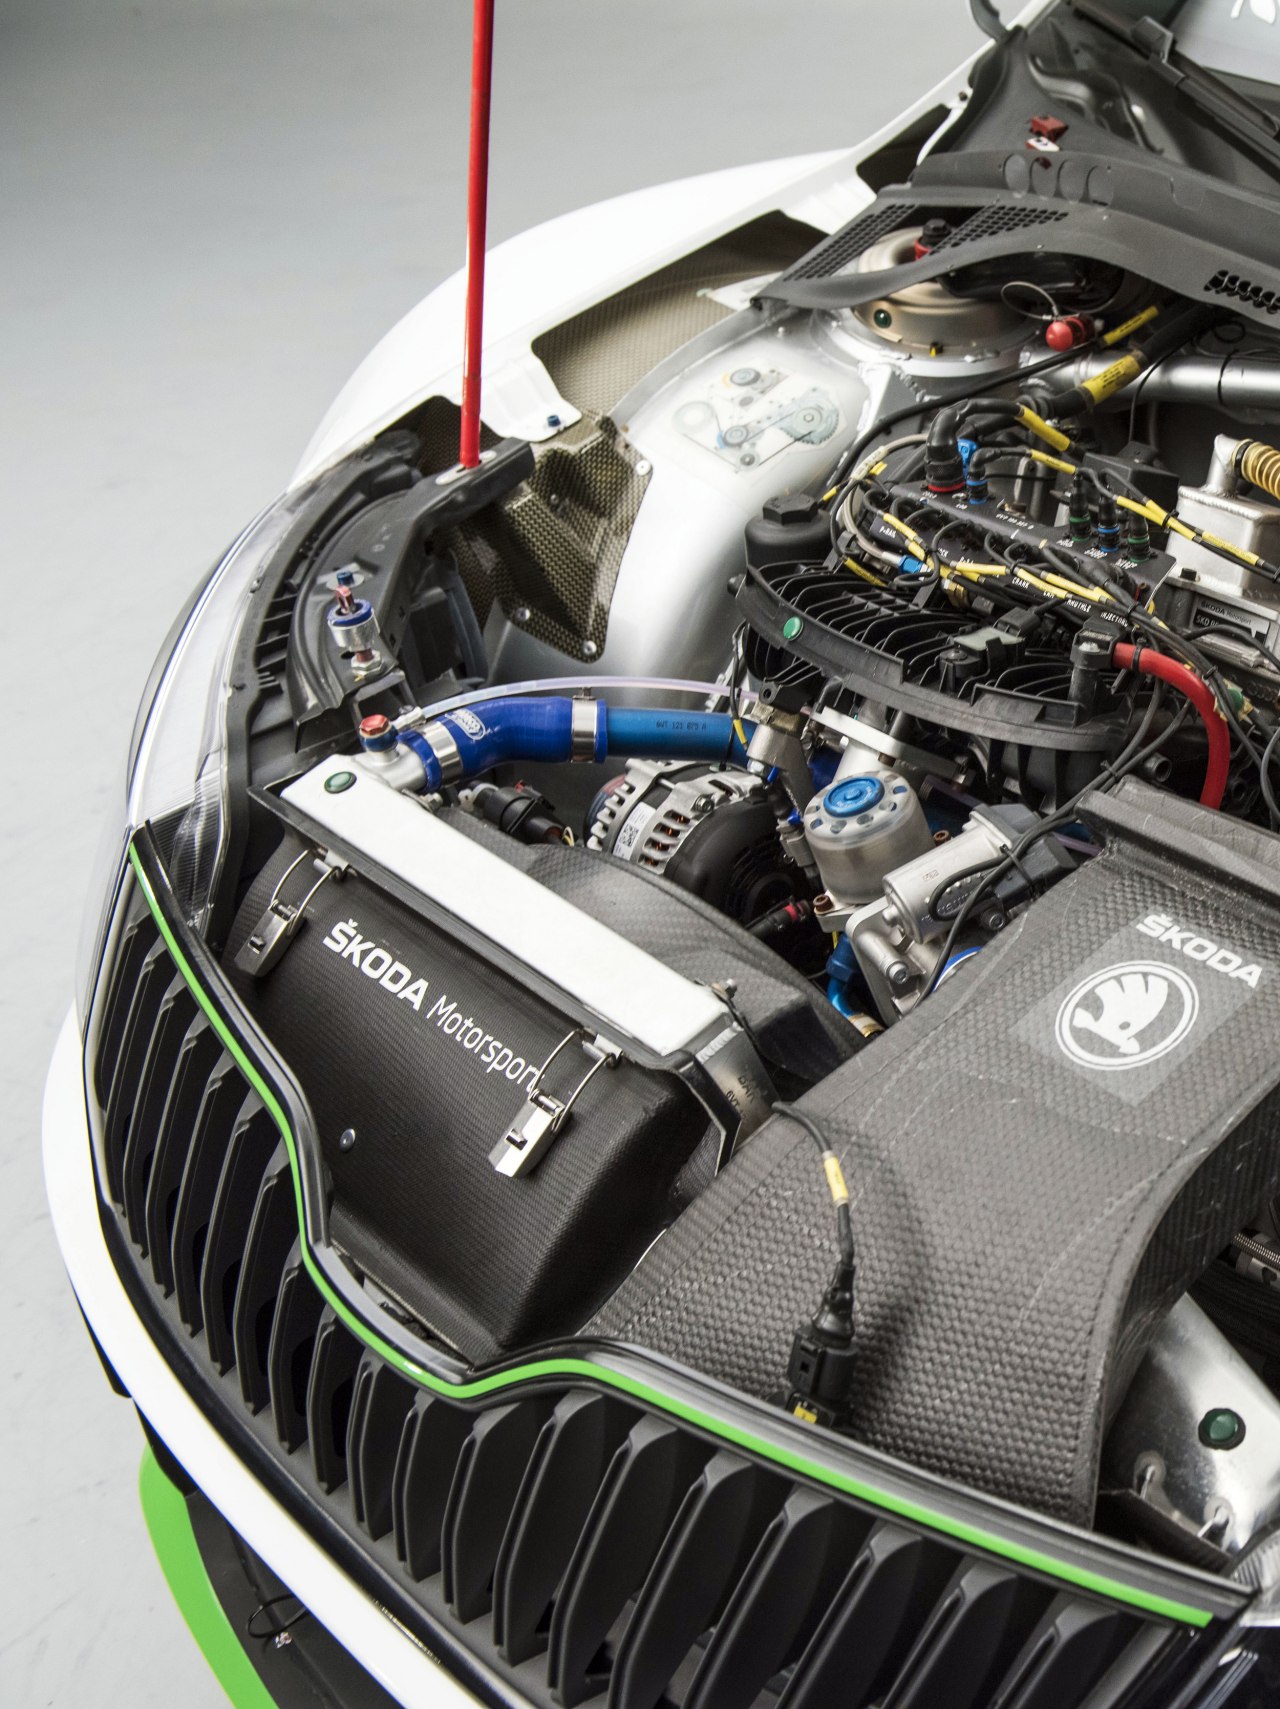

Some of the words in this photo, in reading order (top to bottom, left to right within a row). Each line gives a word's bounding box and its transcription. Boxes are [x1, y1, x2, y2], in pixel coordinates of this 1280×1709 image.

[322, 918, 429, 1012] ŠKODA
[426, 994, 545, 1093] Motorsport
[1136, 913, 1263, 988] ŠKODA
